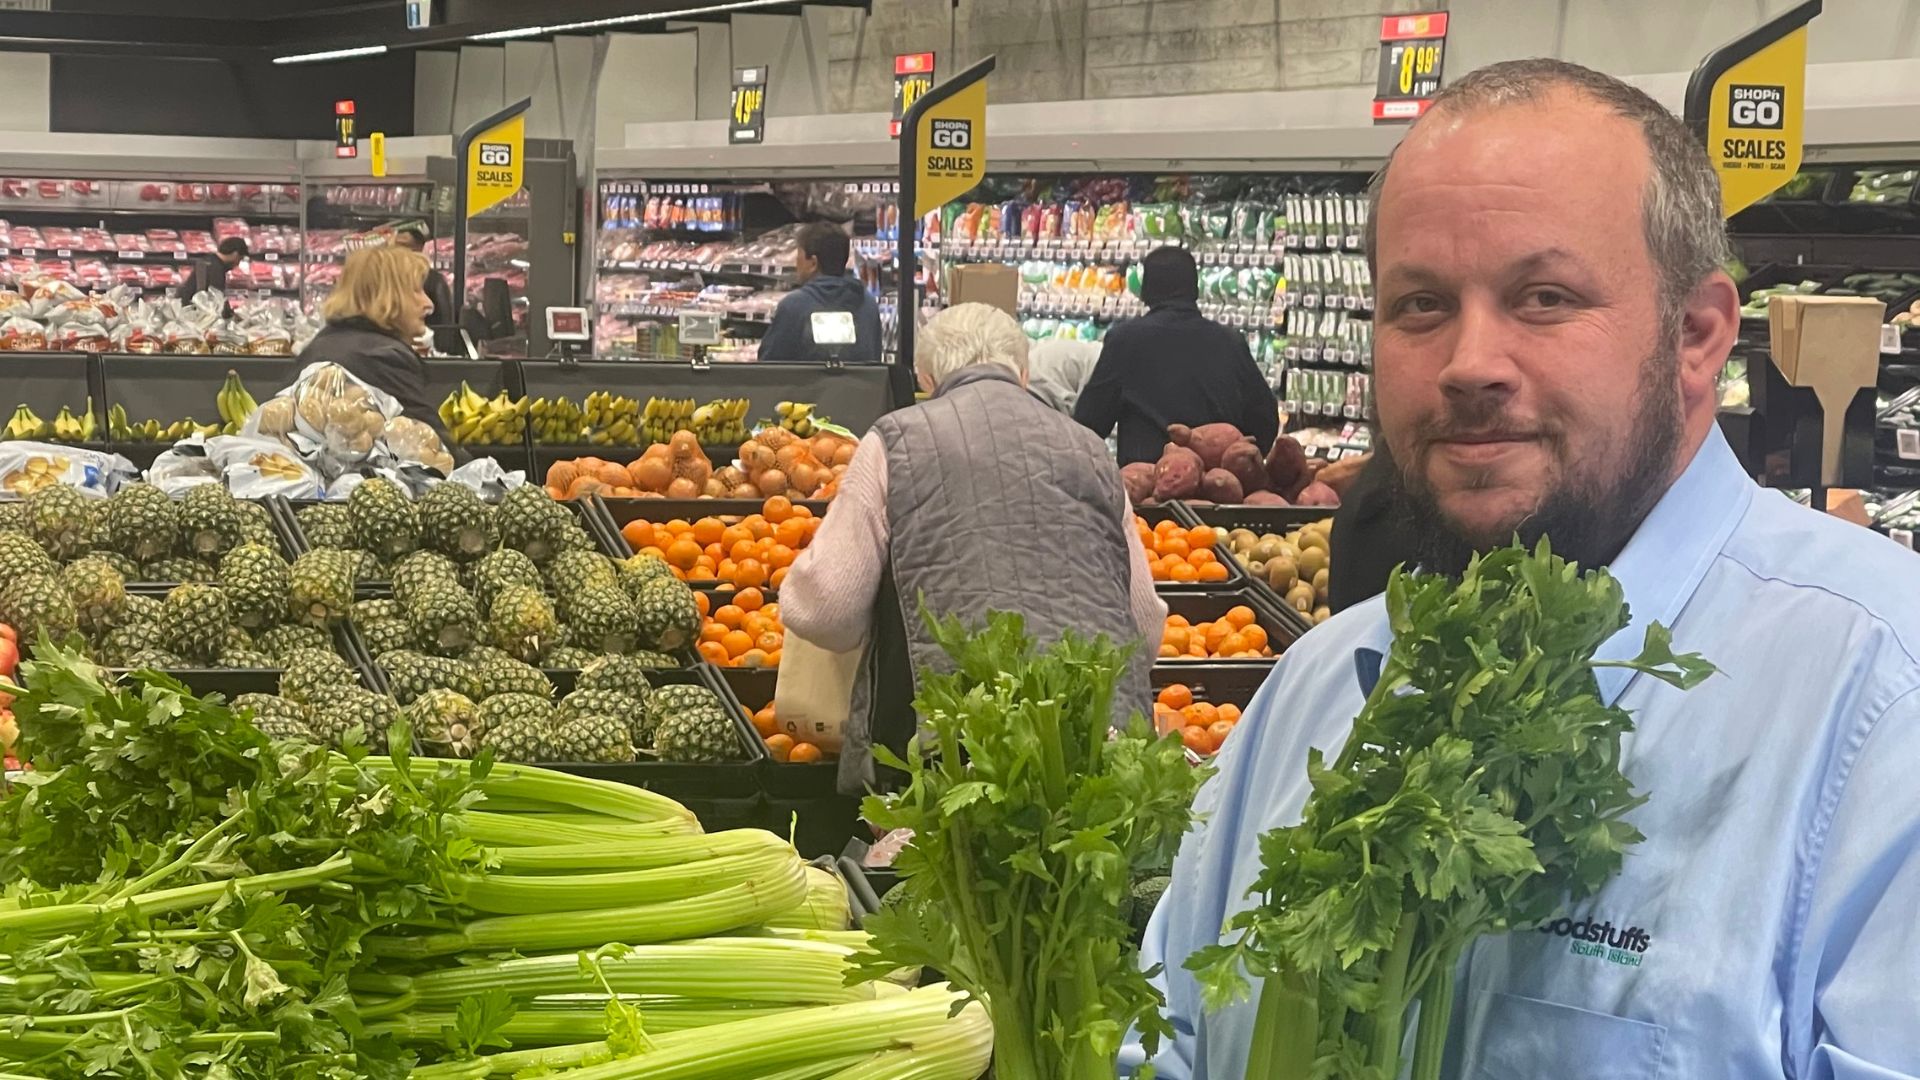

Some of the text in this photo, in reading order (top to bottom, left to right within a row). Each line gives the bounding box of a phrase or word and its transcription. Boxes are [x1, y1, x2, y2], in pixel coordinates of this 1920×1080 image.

[1732, 100, 1780, 125] GO
[933, 129, 968, 147] GO
[481, 150, 509, 165] GO
[1723, 138, 1786, 160] SCALES
[927, 156, 973, 171] SCALES
[477, 171, 512, 182] SCALES
[1570, 940, 1643, 967] South Island
